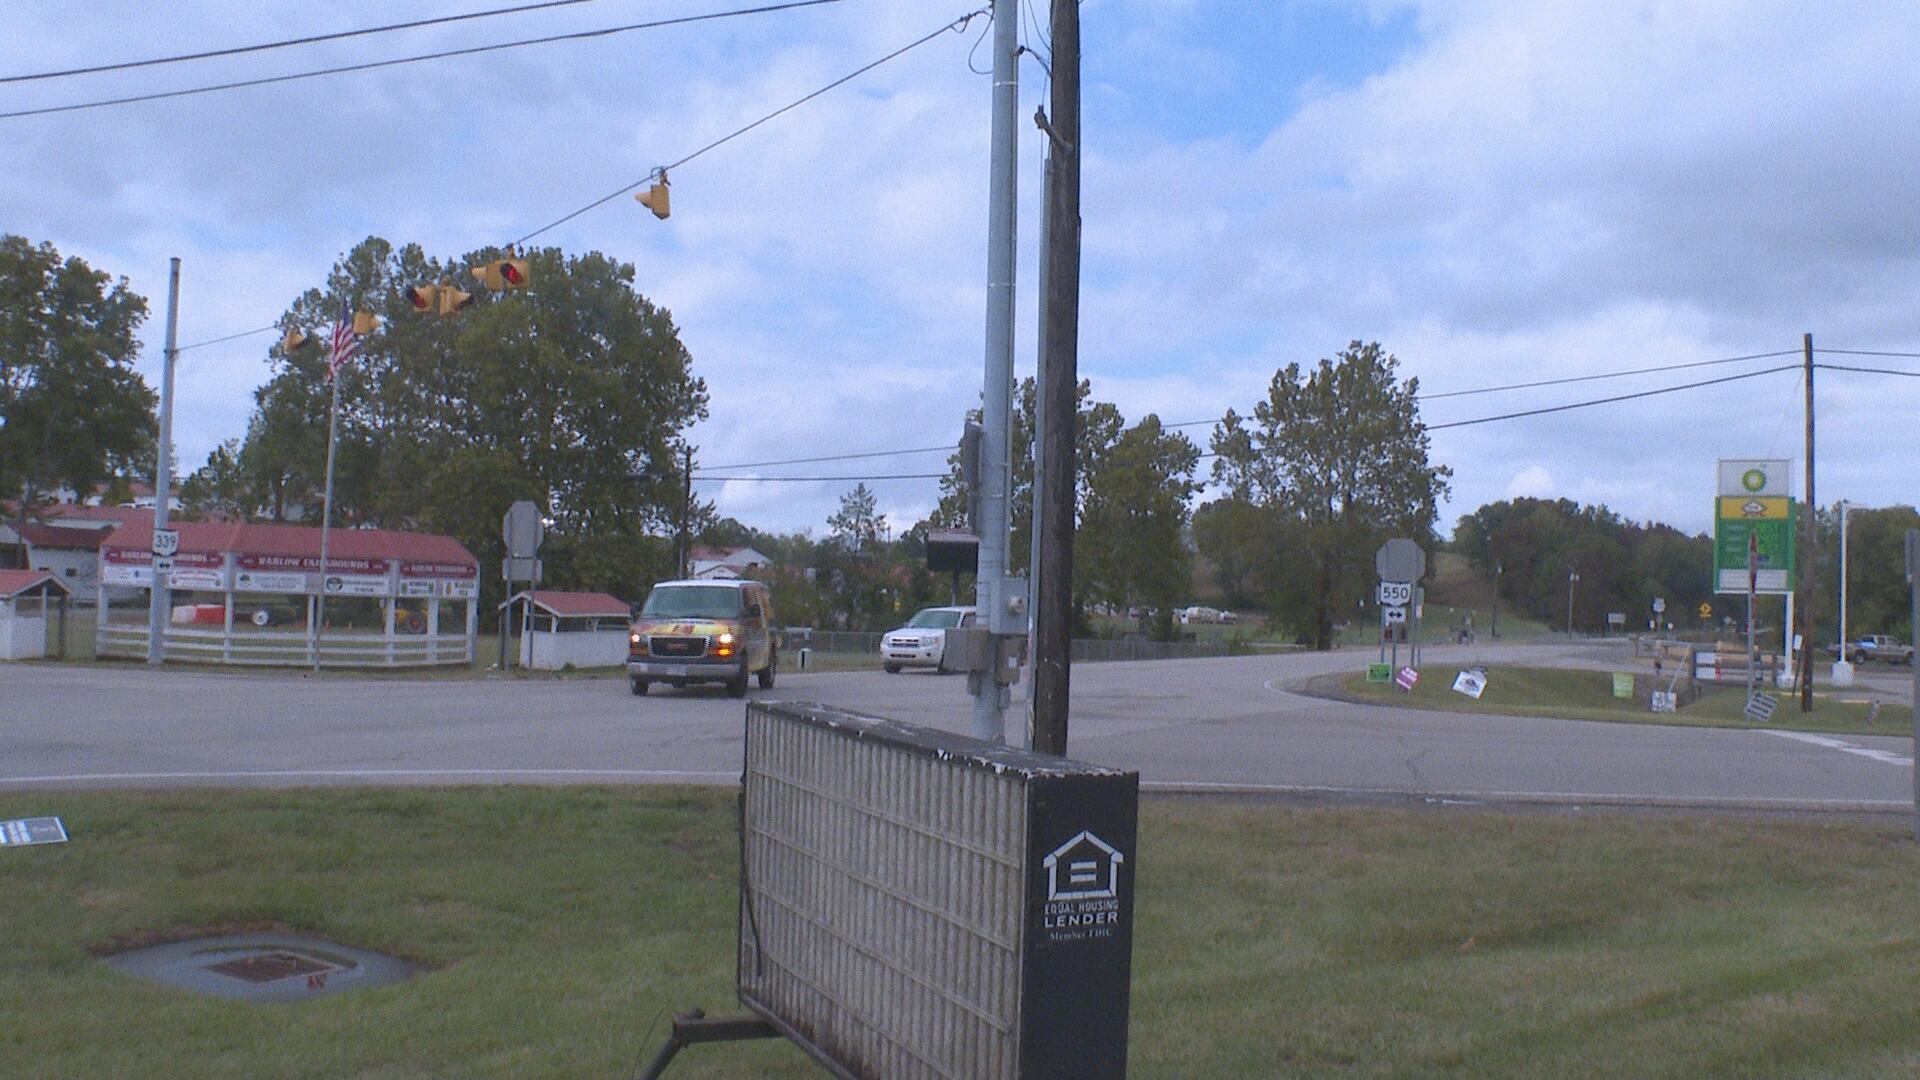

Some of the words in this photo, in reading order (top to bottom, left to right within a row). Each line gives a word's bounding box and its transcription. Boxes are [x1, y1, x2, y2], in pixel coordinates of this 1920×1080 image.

[155, 535, 176, 548] 339
[258, 556, 299, 567] BARLOW
[304, 558, 369, 569] FAIGROUNDS
[1383, 586, 1409, 599] 550
[1044, 902, 1075, 915] EQUAL
[1078, 899, 1119, 913] HOUSING
[1044, 911, 1118, 928] LENDER
